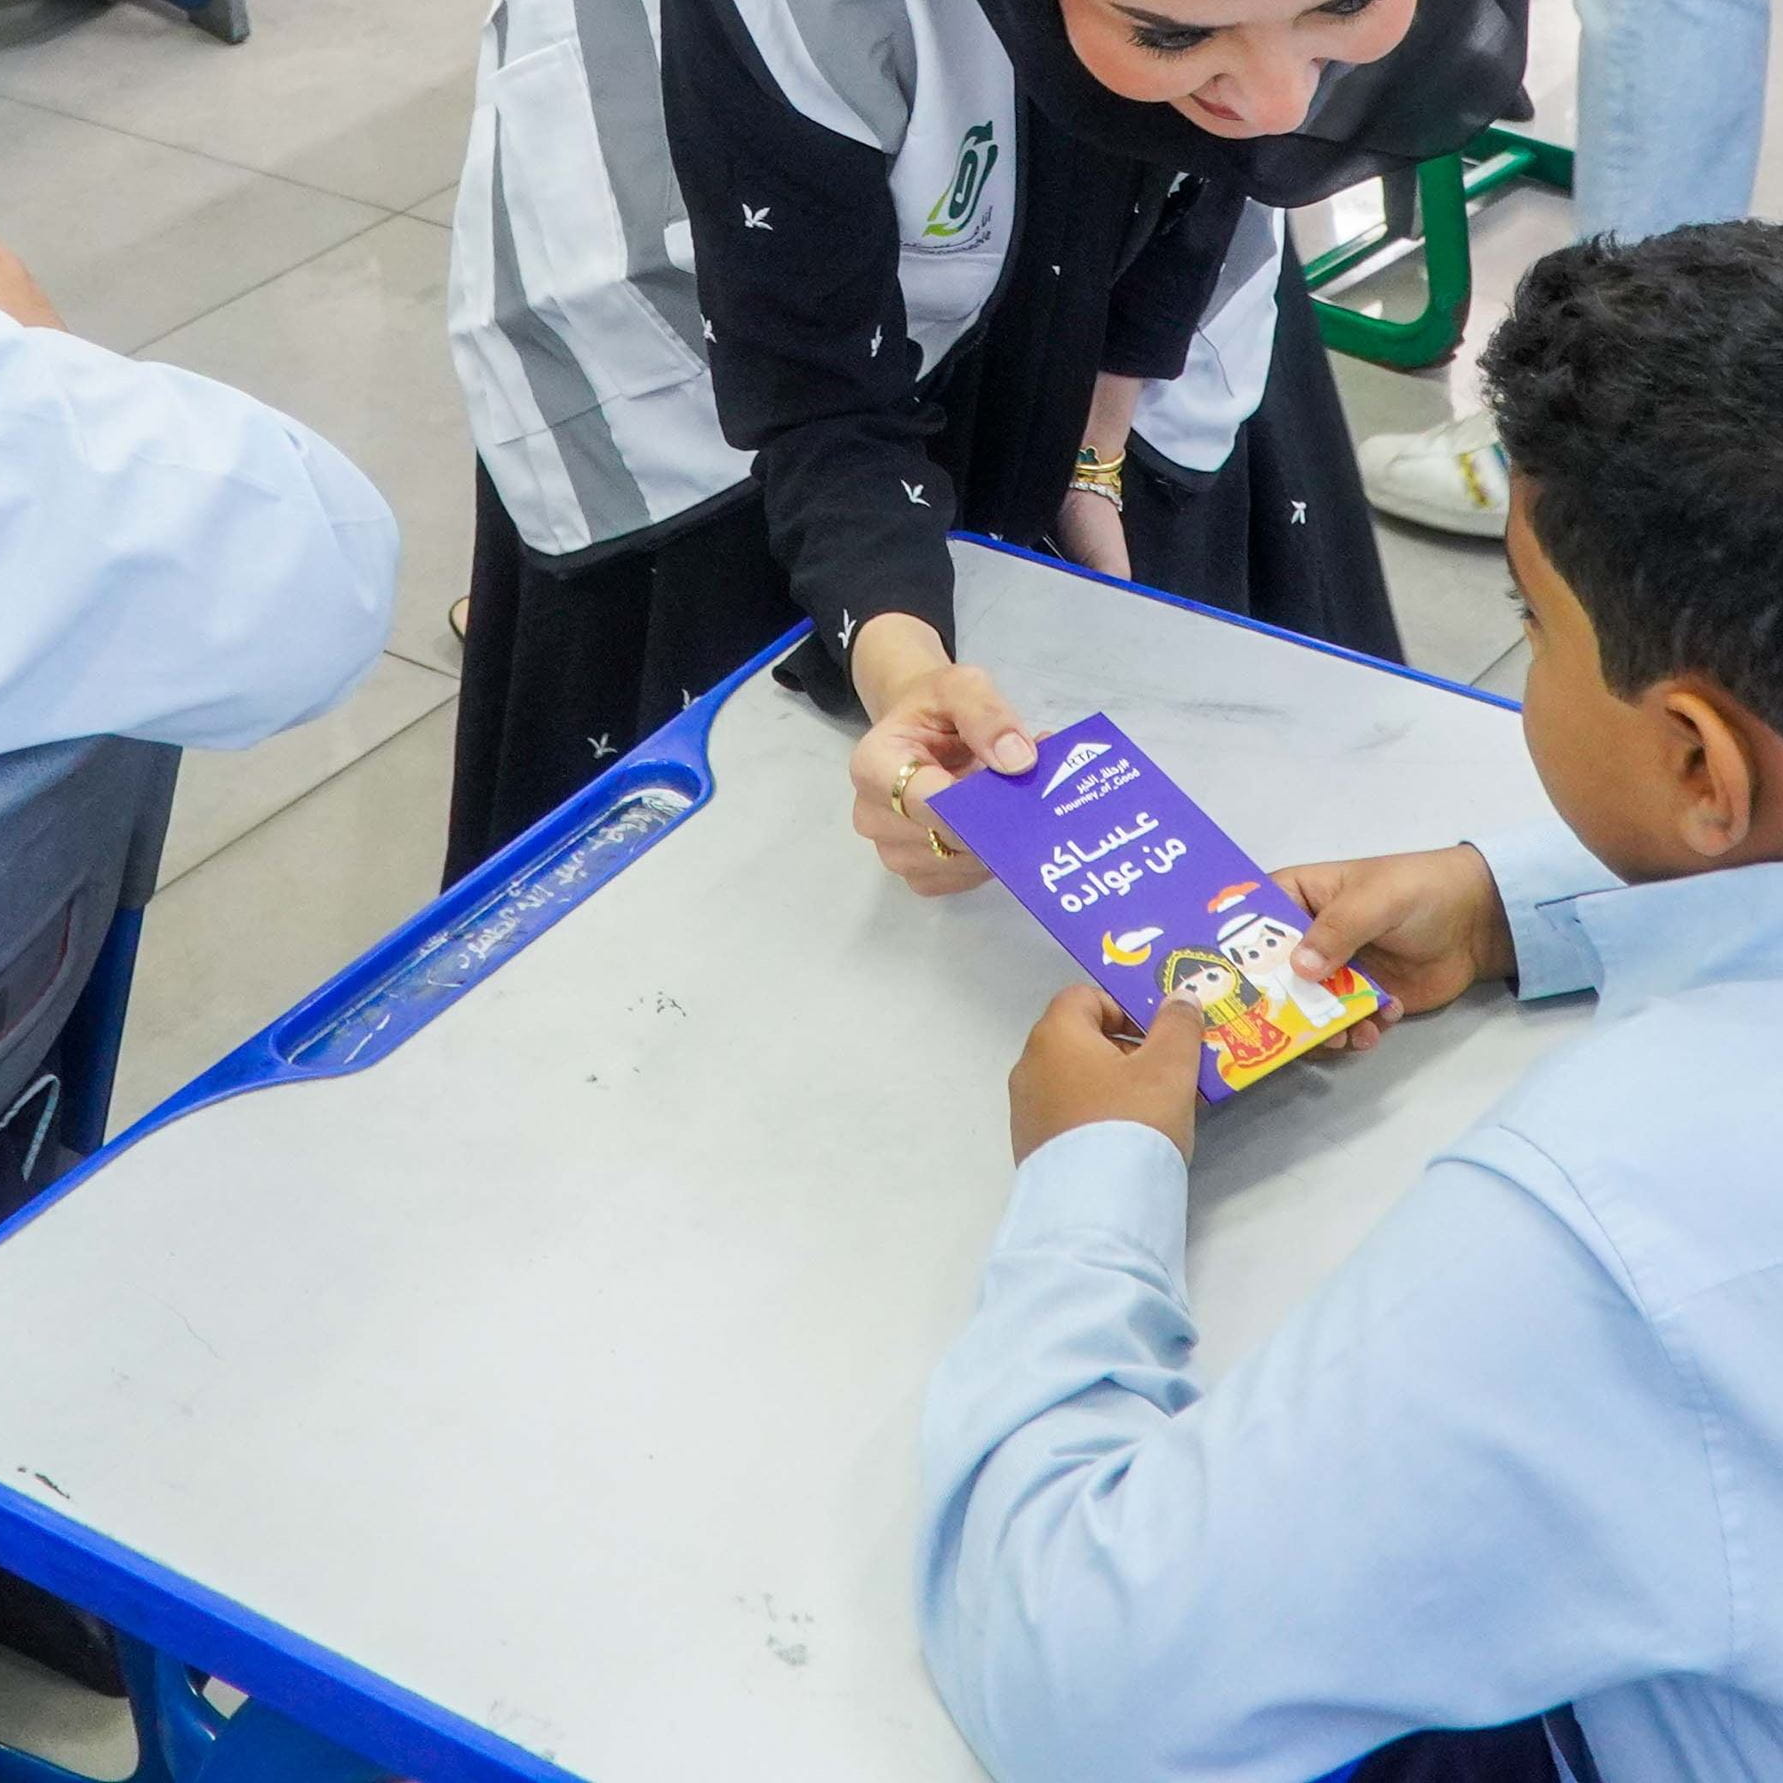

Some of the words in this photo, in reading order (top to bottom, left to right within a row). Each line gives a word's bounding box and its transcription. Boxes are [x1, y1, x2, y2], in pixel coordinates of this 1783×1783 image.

[1065, 749, 1096, 769] RTA
[1039, 811, 1159, 894] عساكم
[1142, 837, 1187, 874] من
[1060, 860, 1144, 913] عواده
